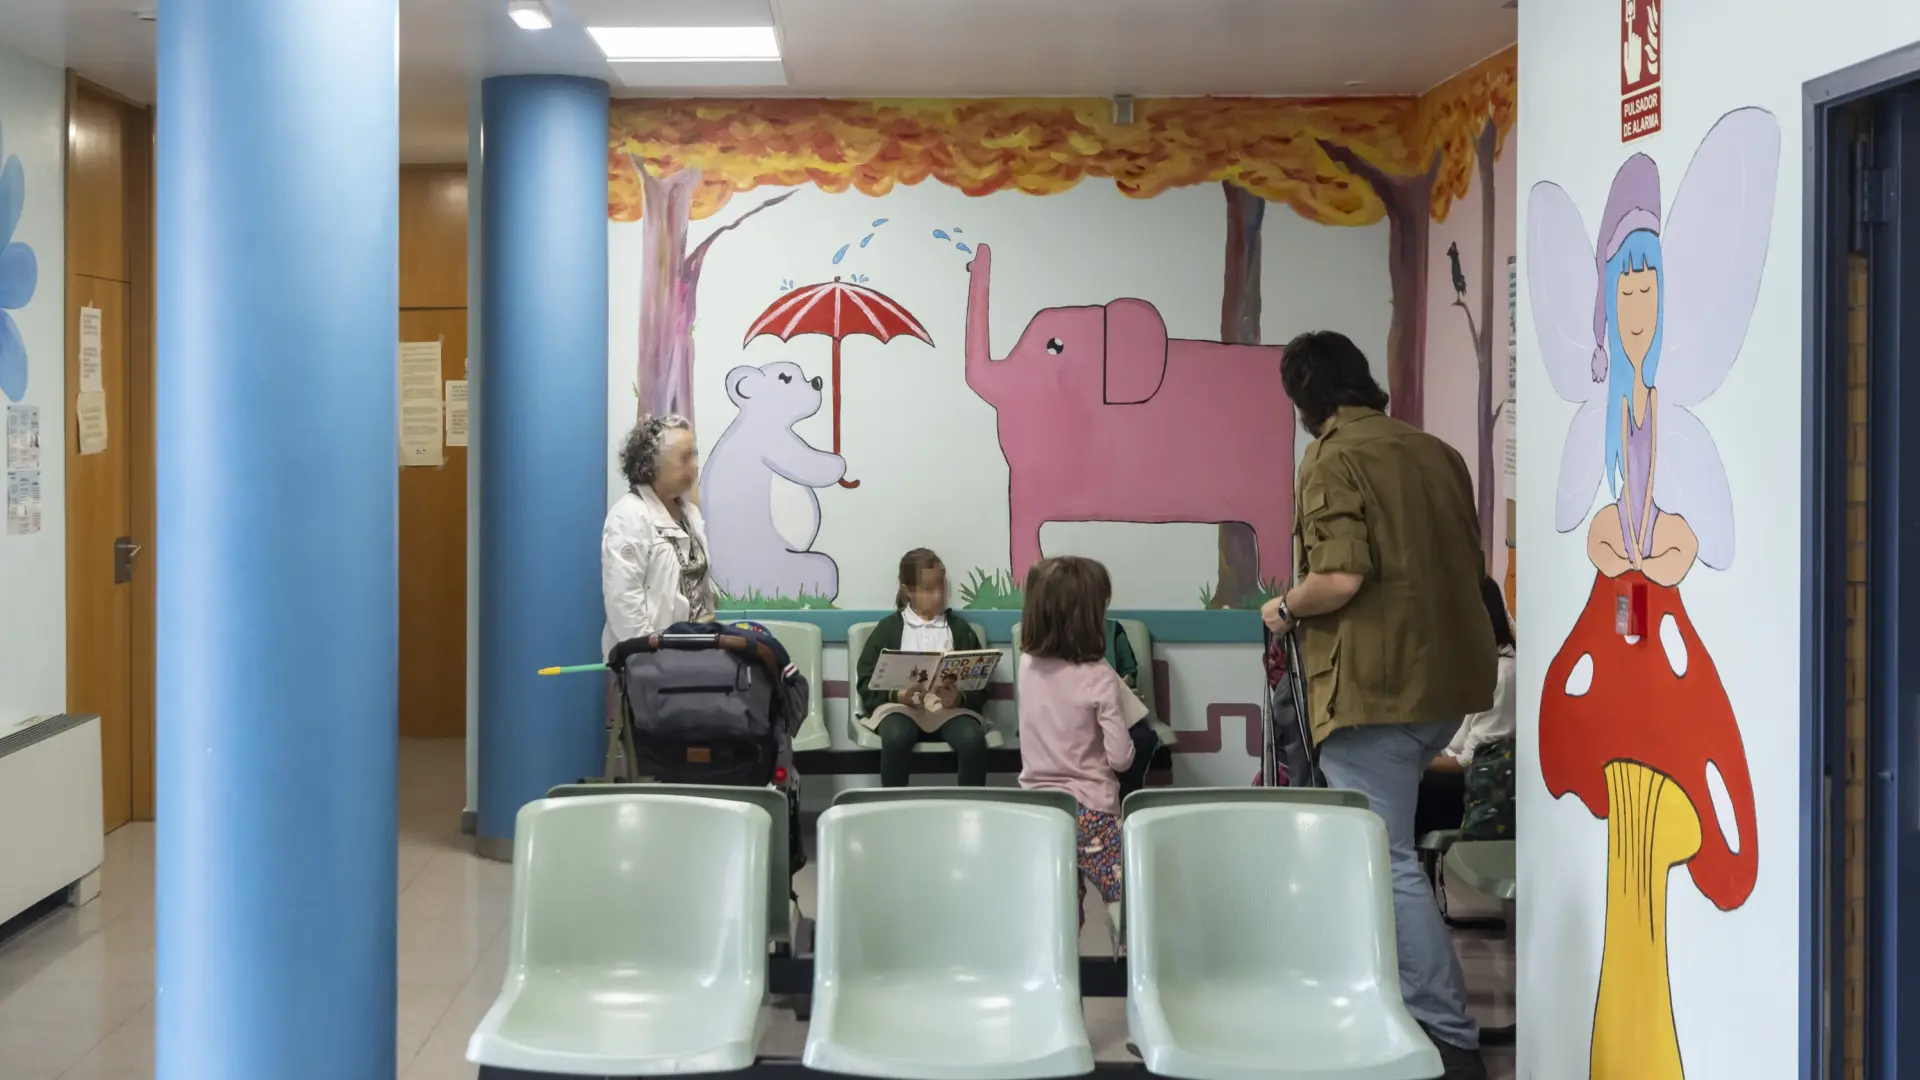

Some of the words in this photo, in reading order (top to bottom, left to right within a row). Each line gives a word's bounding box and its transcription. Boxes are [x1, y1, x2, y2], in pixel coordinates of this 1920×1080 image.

[1624, 93, 1658, 117] PULSADOR
[1623, 121, 1632, 137] DE
[1632, 112, 1659, 134] ALARMA
